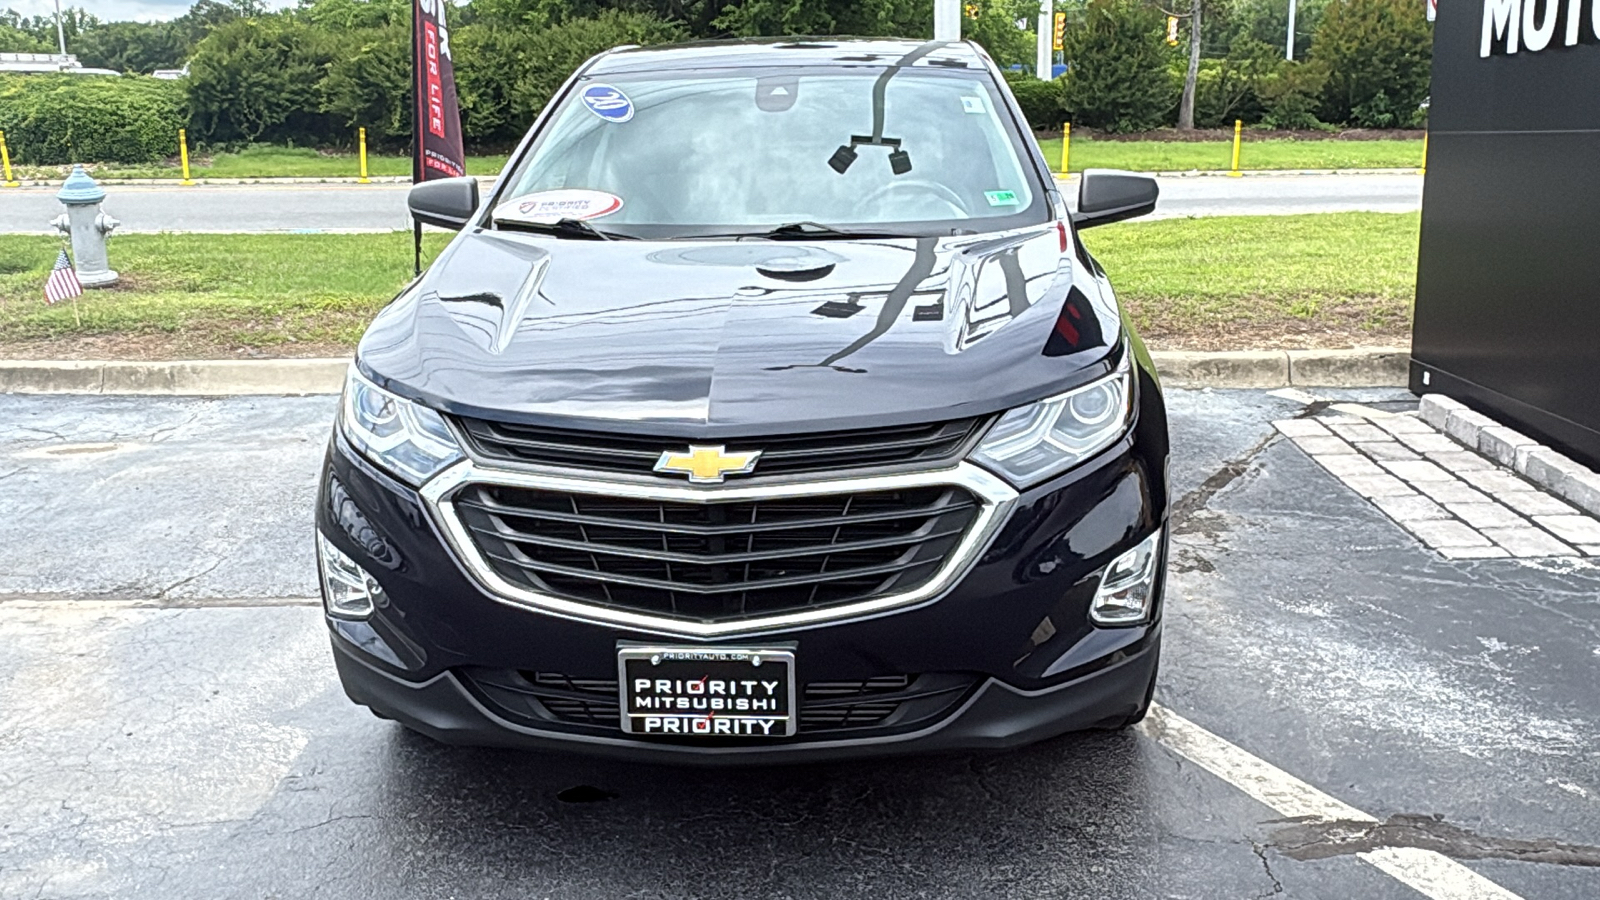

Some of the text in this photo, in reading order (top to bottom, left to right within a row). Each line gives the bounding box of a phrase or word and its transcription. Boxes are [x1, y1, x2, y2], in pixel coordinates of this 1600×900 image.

[1480, 0, 1600, 58] MOT
[428, 29, 441, 131] FOR LIFE
[634, 678, 779, 695] PRIORITY
[635, 697, 777, 710] MITSUBISHI
[644, 717, 775, 735] PRIORITY
